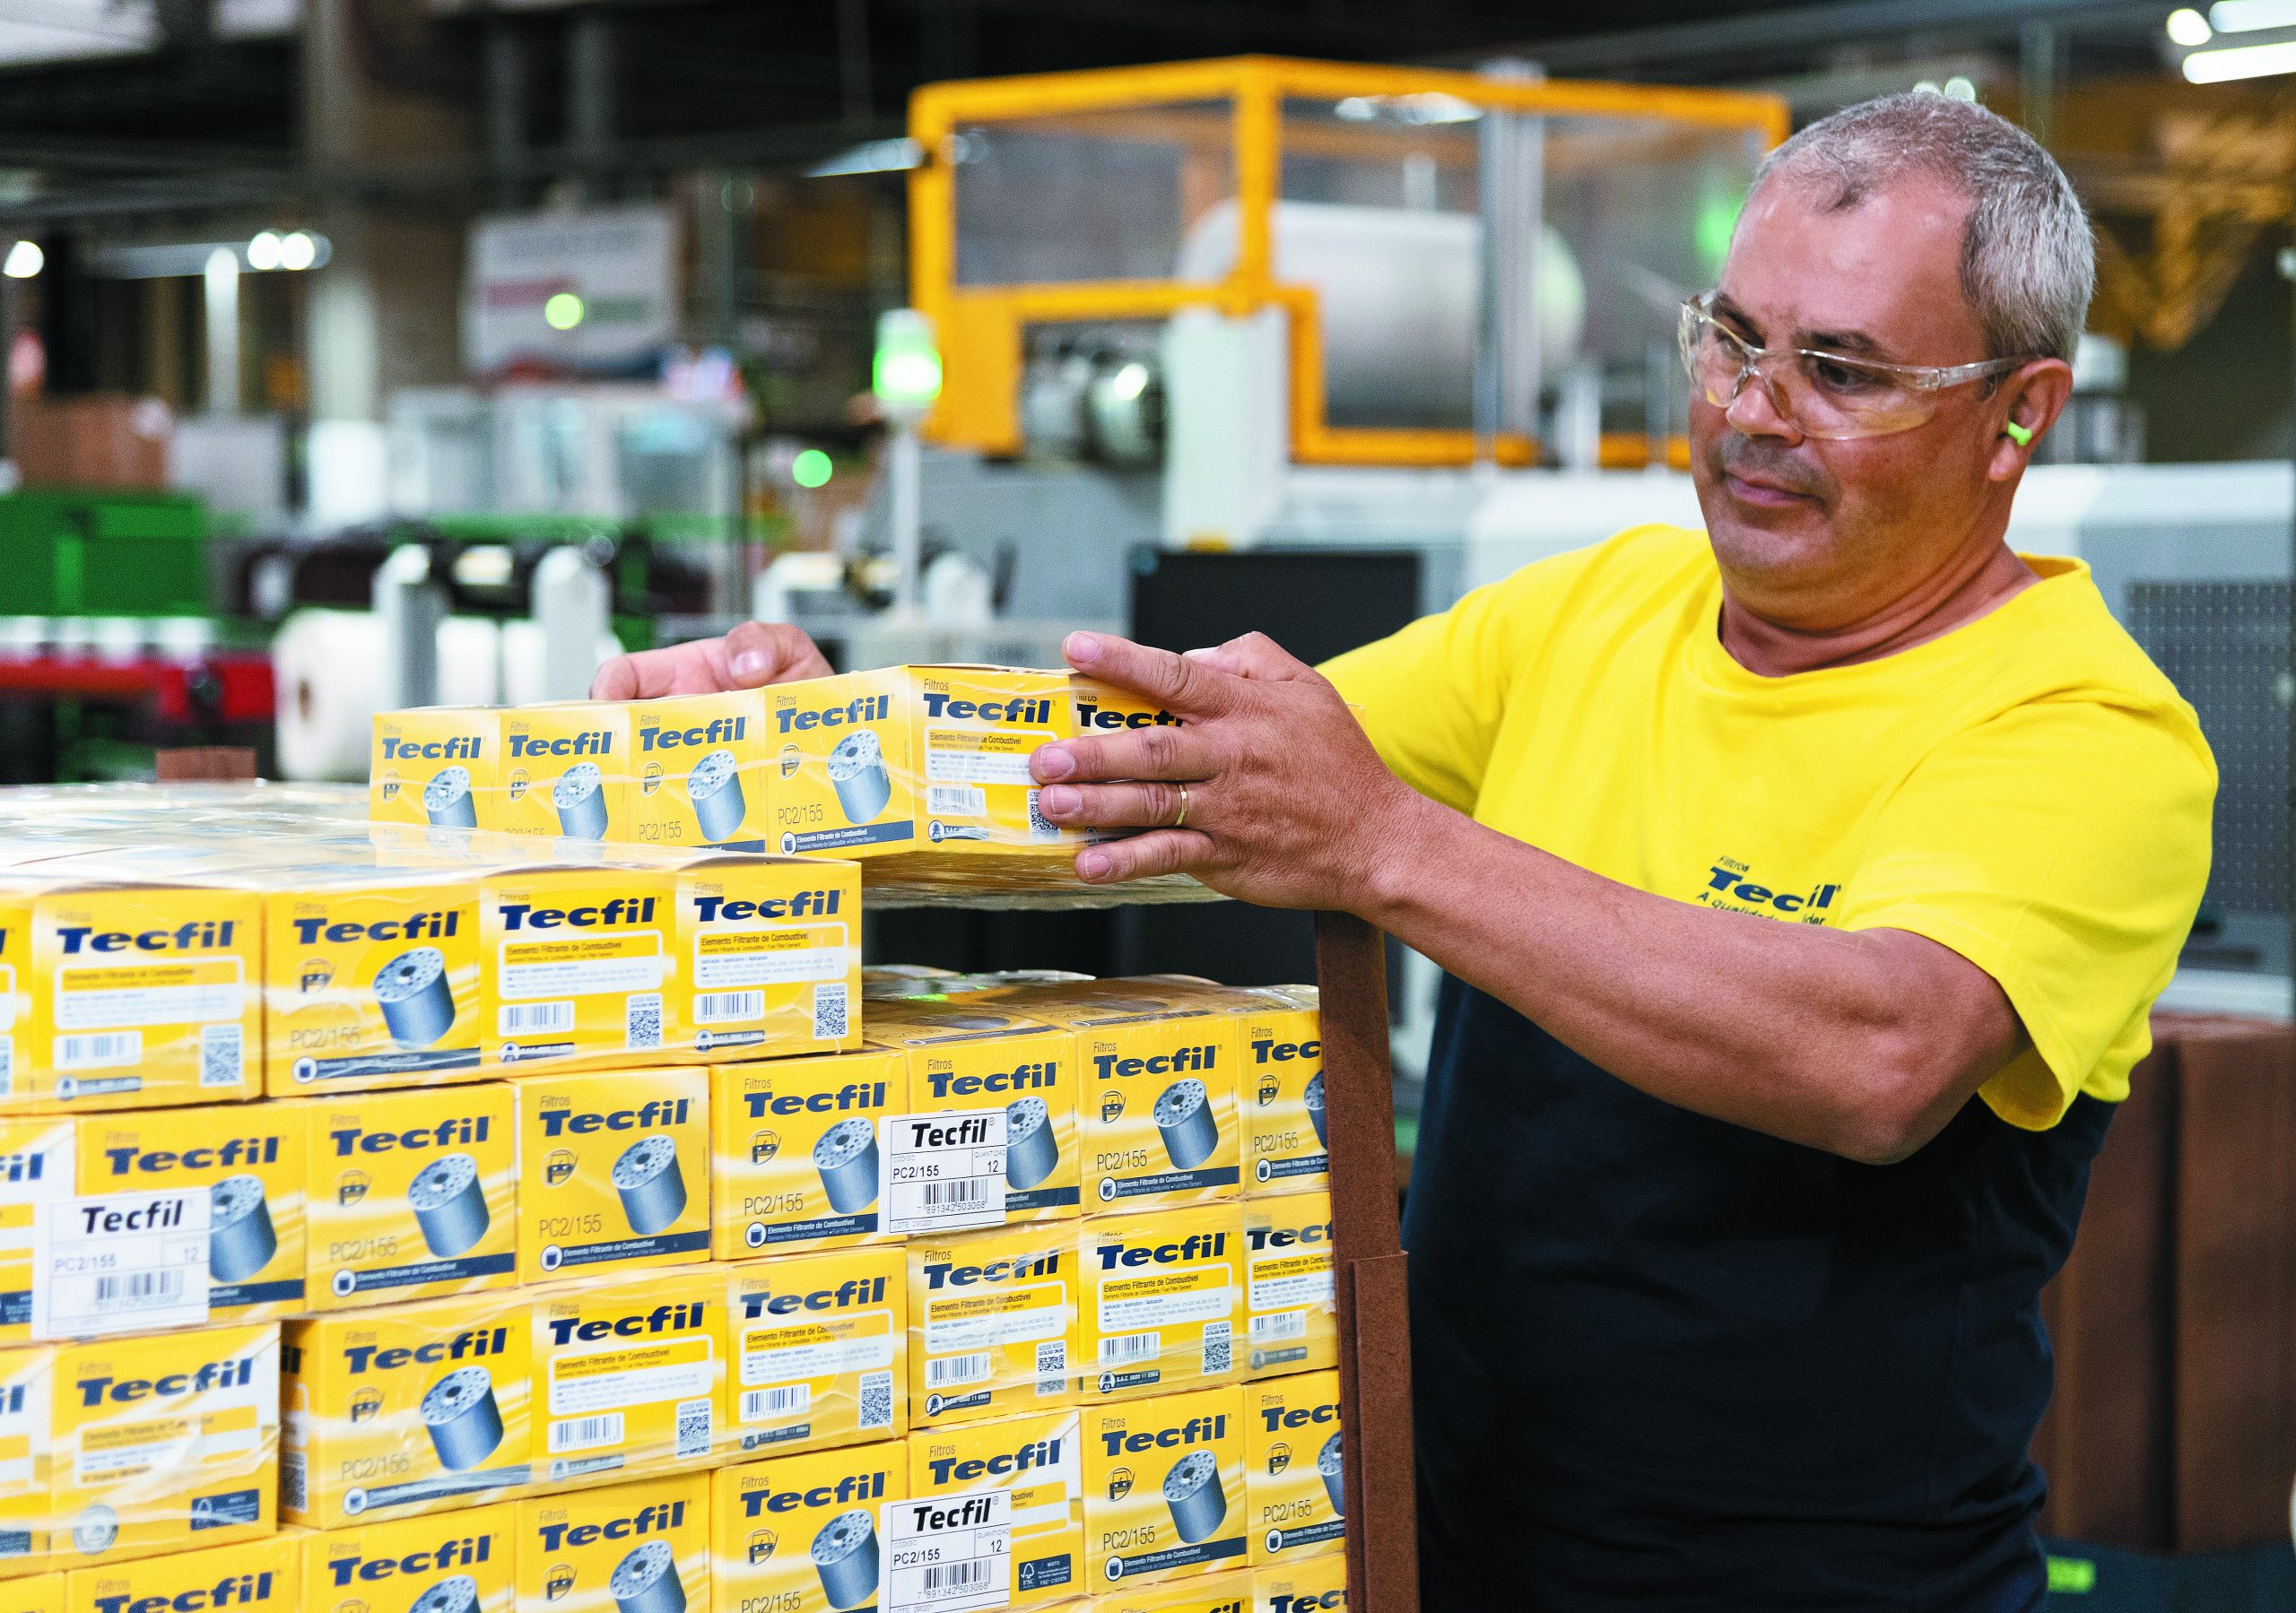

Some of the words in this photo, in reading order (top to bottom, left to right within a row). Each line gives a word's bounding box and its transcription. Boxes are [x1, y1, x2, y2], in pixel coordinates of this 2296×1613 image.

[924, 679, 949, 691] Filtros
[776, 695, 797, 707] Filtros
[924, 693, 1051, 724] Tecfil
[640, 715, 660, 726] Filtros
[776, 695, 889, 733] Tecfil
[1077, 703, 1183, 729] Tecf
[510, 721, 529, 733] Filtros
[639, 716, 745, 752] Tecfil
[382, 737, 482, 759] Tecfil
[509, 732, 612, 757] Tecfil
[778, 804, 823, 826] PC2/155
[639, 820, 682, 842] PC2/155
[797, 835, 816, 843] Elemento
[817, 832, 834, 841] Filtrante
[693, 881, 724, 894] Filtros
[1709, 866, 1836, 912] Tecil
[499, 897, 656, 931] Tecfil
[693, 889, 840, 923] Tecfil
[56, 920, 234, 954] Tecfil
[293, 911, 459, 945] Tecfil
[701, 937, 731, 945] Elemento
[734, 935, 760, 943] Filtrante
[1251, 1027, 1273, 1038] Filtros
[1093, 1041, 1117, 1053] Filtros
[1251, 1040, 1321, 1064] Tec
[927, 1059, 952, 1071] Filtros
[1093, 1045, 1216, 1080] Tecfil
[744, 1078, 772, 1090] Filtros
[927, 1062, 1057, 1097] Tecfil
[540, 1095, 570, 1107] Filtros
[744, 1082, 885, 1118] Tecfil
[539, 1098, 689, 1137] Tecfil
[330, 1115, 490, 1157] Tecfil
[911, 1118, 987, 1148] Tecfil
[1254, 1132, 1299, 1153] PC2/155
[105, 1136, 279, 1176] Tecfil
[987, 1160, 998, 1173] 12
[1097, 1149, 1147, 1172] PC2/155
[893, 1165, 939, 1179] PC2/155
[1118, 1181, 1139, 1189] Elemento
[744, 1193, 804, 1216] PC2/155
[926, 1203, 955, 1214] 891342
[957, 1201, 985, 1211] 503068
[82, 1199, 183, 1234] Tecfil
[539, 1214, 602, 1239] PC2/155
[768, 1225, 793, 1234] Elemento
[794, 1223, 814, 1231] Filtrante
[1247, 1220, 1333, 1251] Tec
[183, 1247, 198, 1262] 12
[329, 1236, 396, 1262] PC2/155
[924, 1250, 952, 1262] Filtros
[1097, 1233, 1225, 1270] Tecfil
[924, 1249, 1059, 1289] Tecfil
[1254, 1262, 1279, 1272] Elemento
[1280, 1260, 1300, 1269] Filtrante
[740, 1278, 770, 1291] Filtros
[1104, 1284, 1131, 1293] Elemento
[1133, 1280, 1156, 1289] Filtrante
[740, 1277, 886, 1319] Tecfil
[931, 1303, 959, 1313] Elemento
[961, 1299, 985, 1309] Filtrante
[549, 1302, 704, 1346] Tecfil
[747, 1333, 778, 1342] Elemento
[779, 1330, 806, 1339] Filtrante
[344, 1327, 507, 1375] Tecfil
[76, 1357, 253, 1407] Tecfil
[1261, 1395, 1283, 1406] Filtros
[1101, 1418, 1126, 1430] Filtros
[1261, 1404, 1342, 1433] Tec
[1101, 1415, 1225, 1457] Tecfil
[928, 1439, 1061, 1486] Tecfil
[929, 1444, 956, 1458] Filtros
[741, 1476, 769, 1489] Filtros
[740, 1471, 885, 1518] Tecfil
[539, 1509, 567, 1522] Filtros
[913, 1497, 991, 1532] Tecfil
[1264, 1498, 1312, 1524] PC2/155
[538, 1500, 685, 1552] Tecfil
[990, 1539, 1002, 1553] 12
[1103, 1526, 1155, 1551] PC2/155
[328, 1534, 491, 1587] Tecfil
[893, 1548, 940, 1565] PC2/155
[1125, 1558, 1146, 1567] Elemento
[1147, 1555, 1165, 1563] Filtrante
[94, 1571, 274, 1613] Tecfil
[742, 1591, 801, 1613] PC2/155
[926, 1587, 956, 1600] 891342
[959, 1582, 988, 1594] 503068
[1270, 1589, 1348, 1613] Tec
